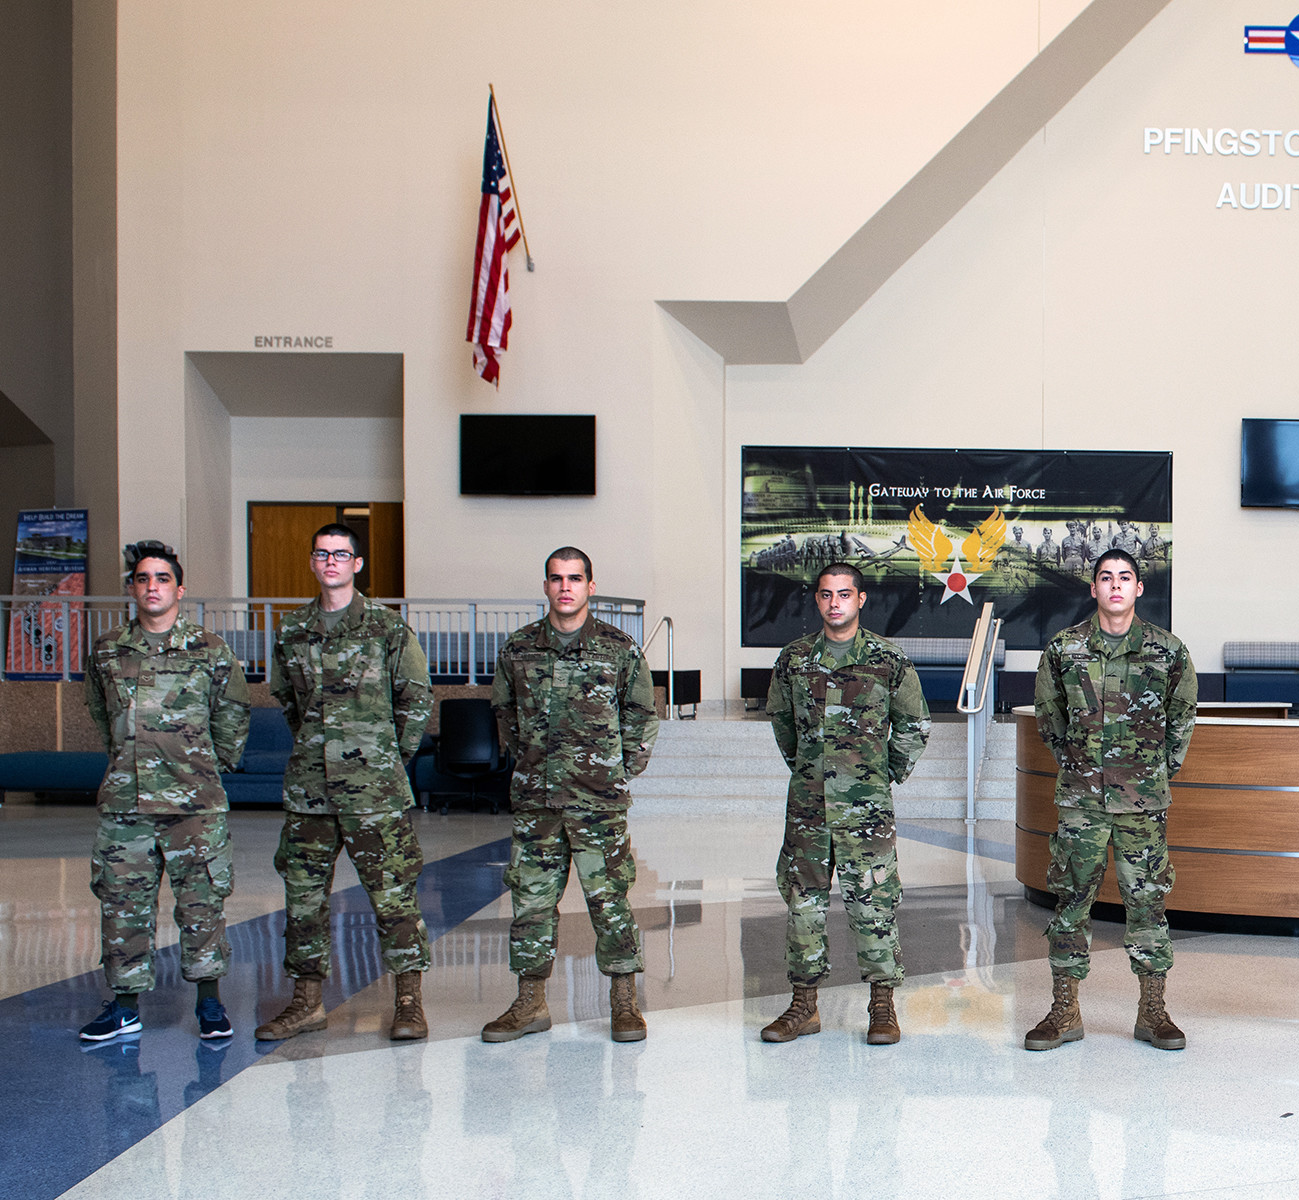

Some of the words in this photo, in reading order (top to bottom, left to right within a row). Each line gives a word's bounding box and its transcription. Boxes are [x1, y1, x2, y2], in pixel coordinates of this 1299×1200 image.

[253, 335, 334, 349] ENTRANCE
[868, 483, 930, 499] GATEWAY
[934, 486, 951, 499] TO
[957, 486, 978, 499] THE
[982, 484, 1005, 499] AIR
[1009, 485, 1046, 502] FORCE
[66, 512, 85, 520] DREAM
